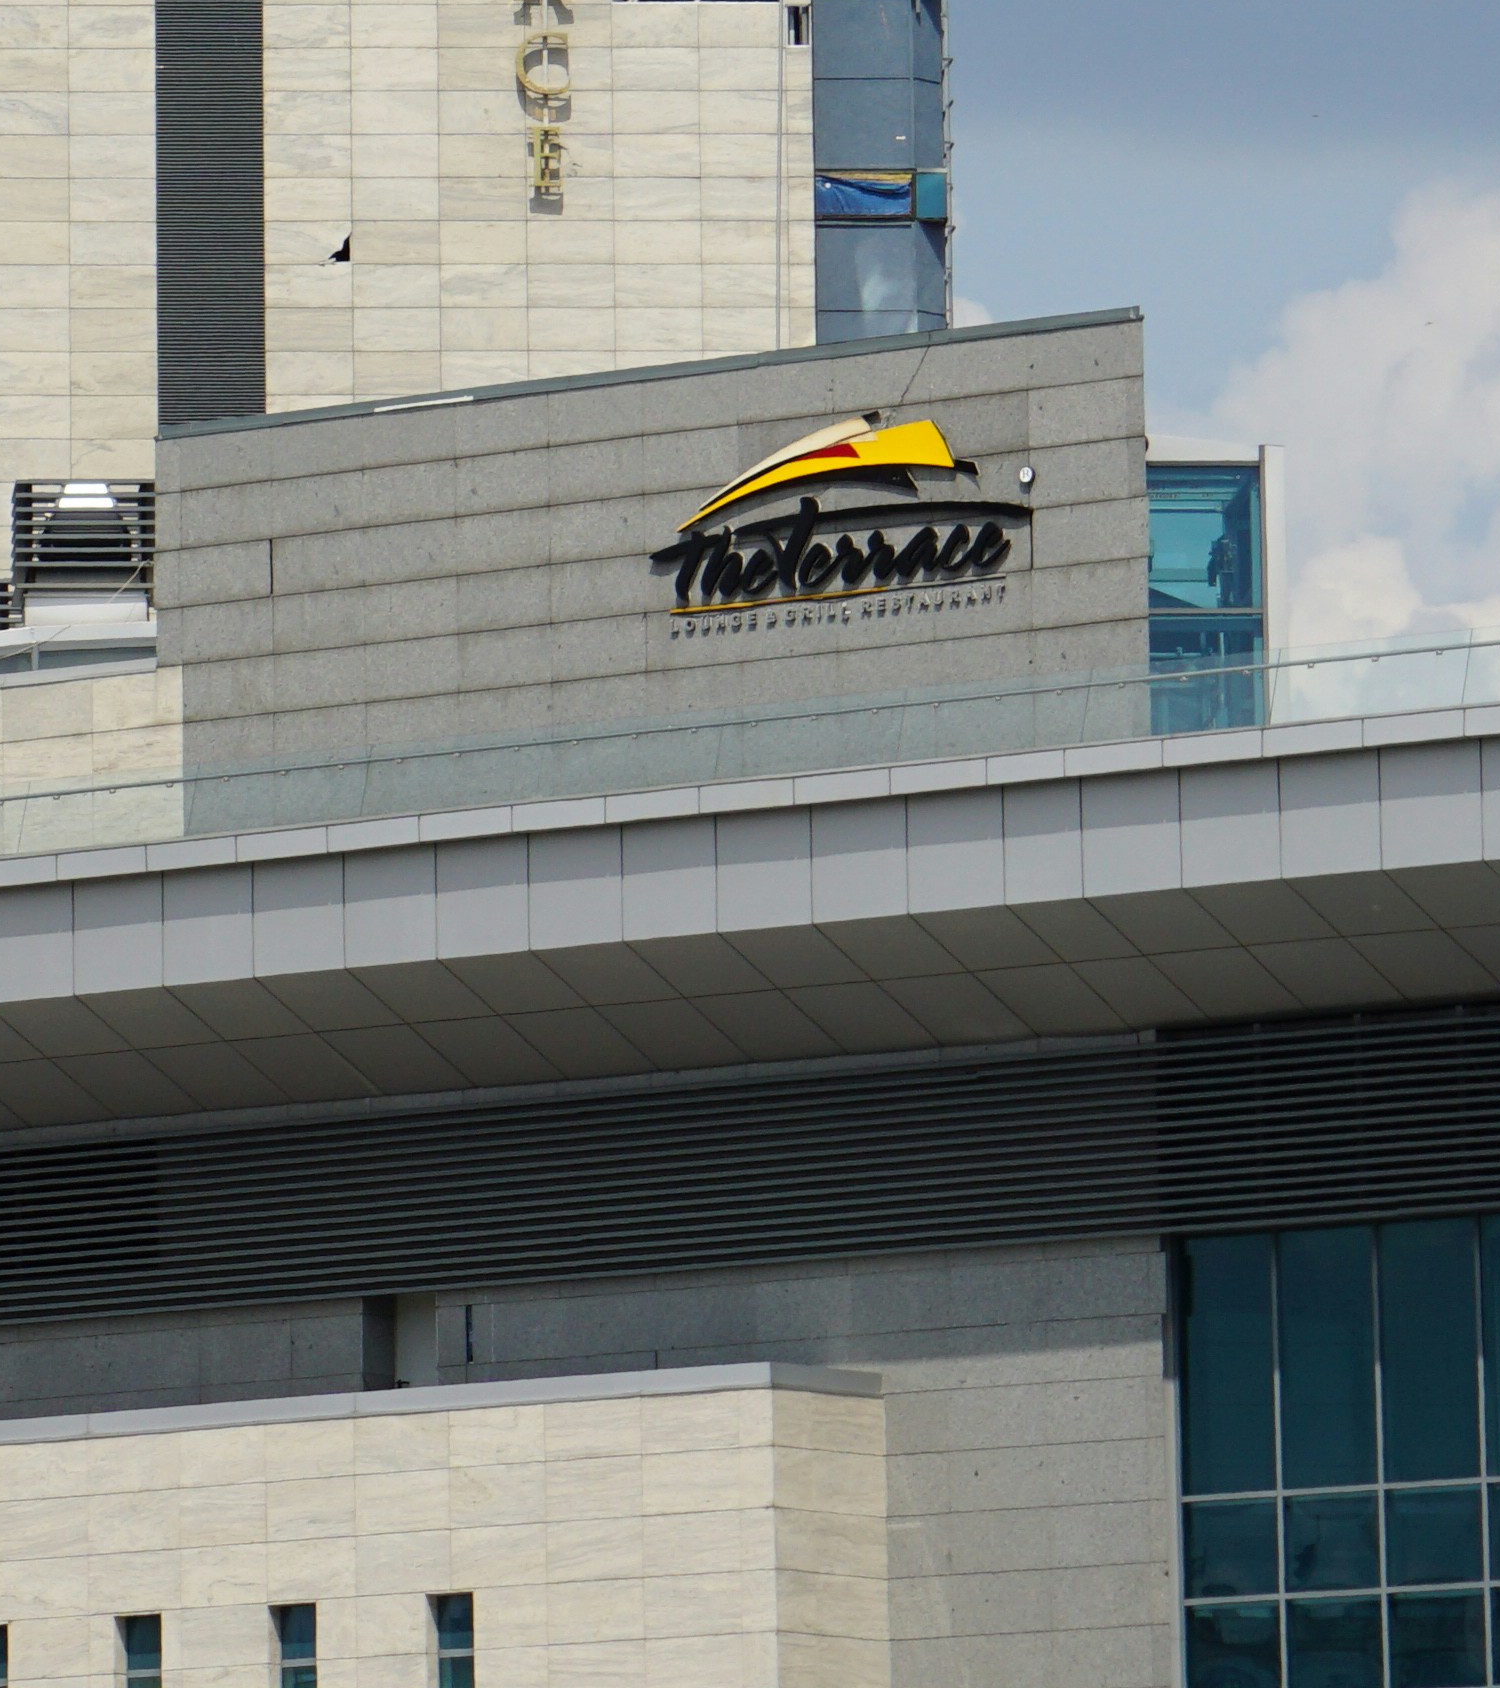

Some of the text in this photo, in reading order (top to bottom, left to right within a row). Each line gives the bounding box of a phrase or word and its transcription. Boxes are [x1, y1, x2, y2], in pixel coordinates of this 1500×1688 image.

[669, 611, 757, 633] LOUNGE
[784, 600, 852, 622] GRILL
[860, 583, 1006, 612] RESTAURANT
